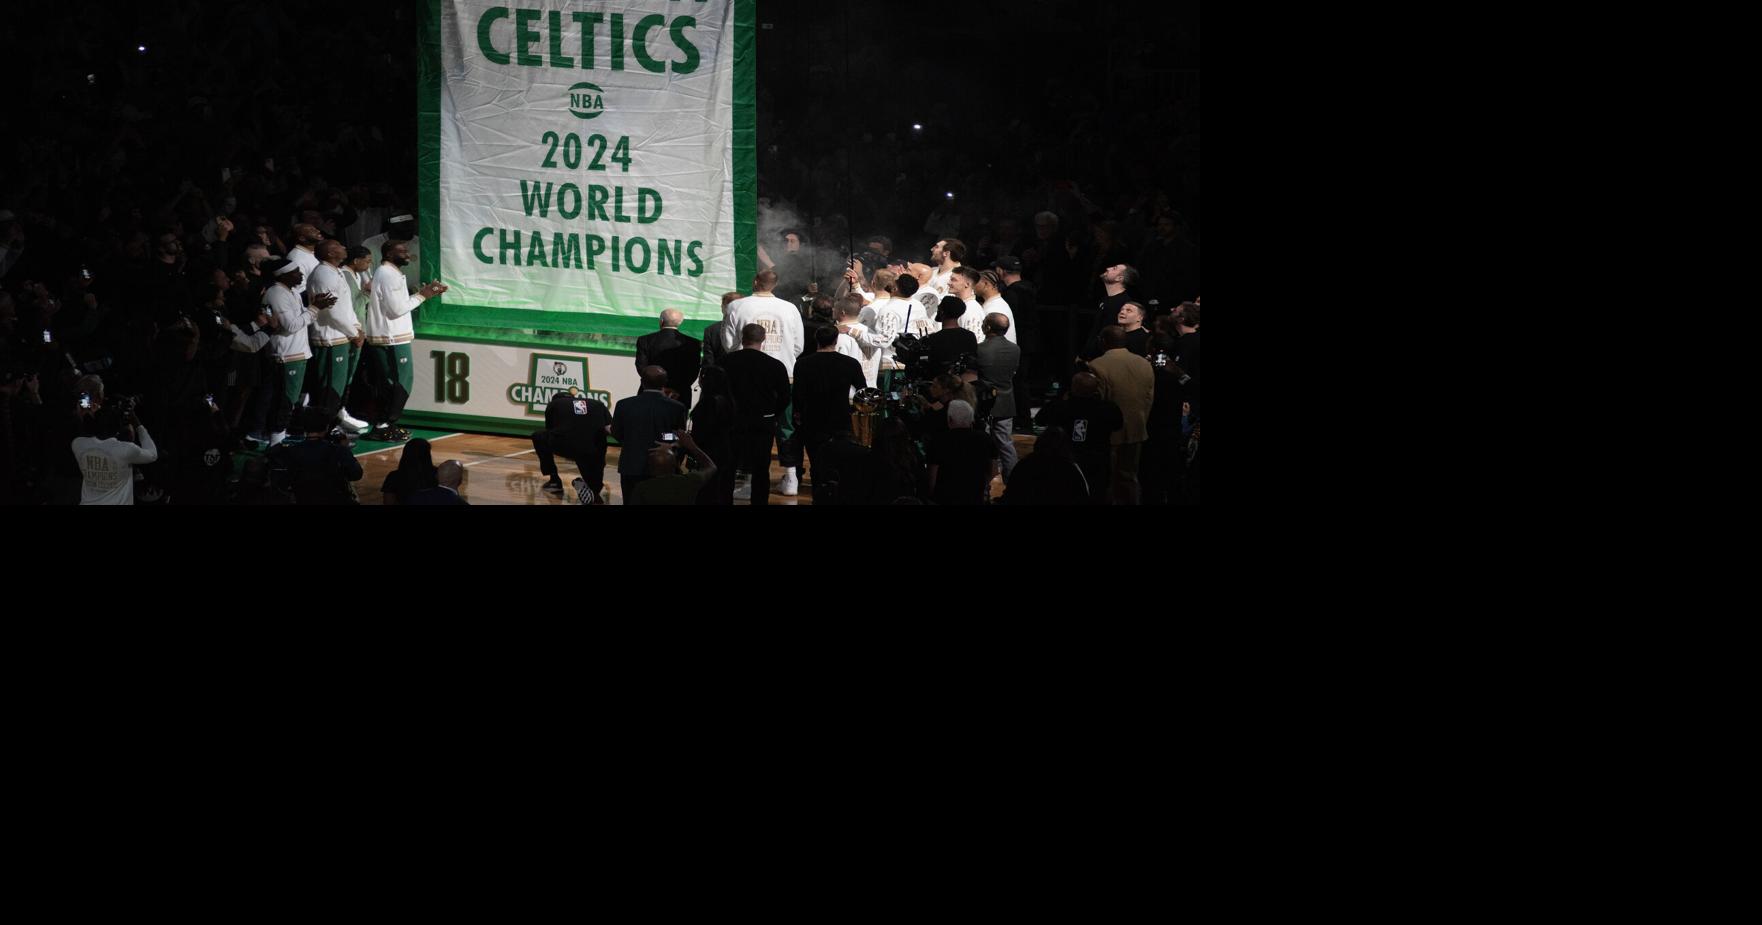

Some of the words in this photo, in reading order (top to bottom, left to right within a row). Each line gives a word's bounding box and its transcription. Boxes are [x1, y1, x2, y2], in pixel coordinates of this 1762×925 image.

[477, 8, 698, 74] CELTICS
[570, 93, 604, 109] NBA
[542, 131, 632, 172] 2024
[520, 180, 663, 224] WORLD
[473, 227, 704, 277] CHAMPIONS
[431, 351, 470, 403] 18
[541, 376, 559, 384] 2024
[562, 377, 578, 386] NBA
[86, 455, 109, 471] NBA
